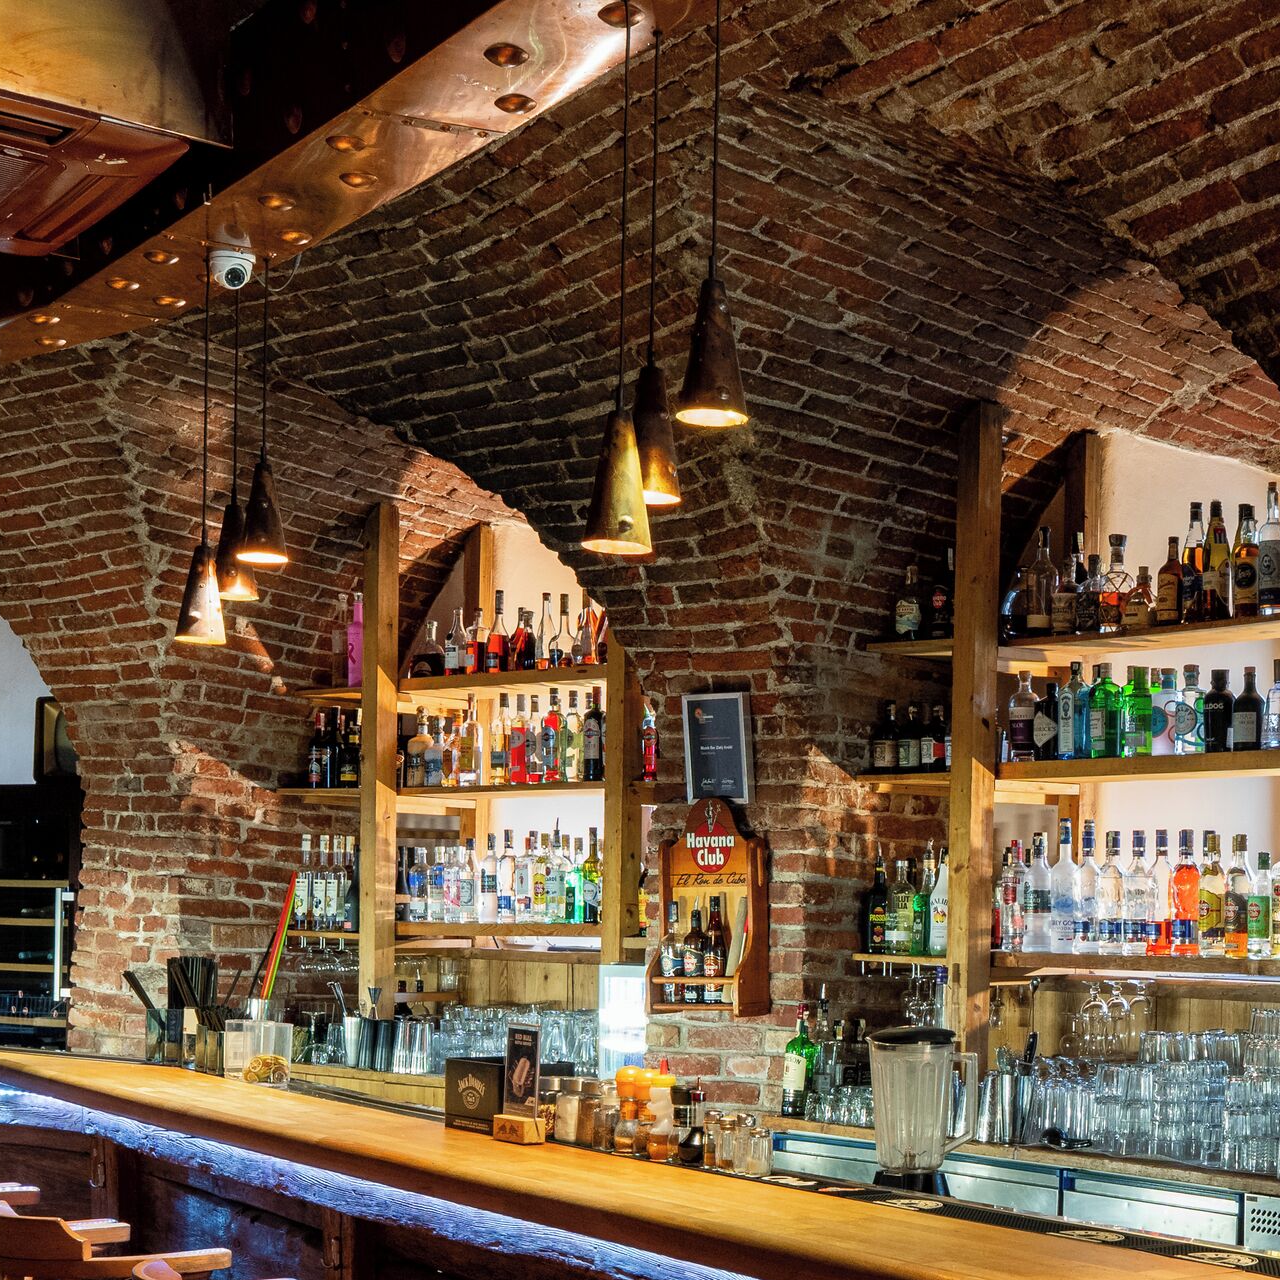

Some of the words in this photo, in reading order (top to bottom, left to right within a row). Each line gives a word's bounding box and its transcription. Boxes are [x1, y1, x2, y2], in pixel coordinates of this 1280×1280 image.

[686, 832, 735, 848] Havana
[696, 848, 724, 866] Club
[676, 873, 690, 886] El
[693, 873, 710, 886] Ron
[713, 873, 723, 885] de
[726, 872, 746, 884] Cuba
